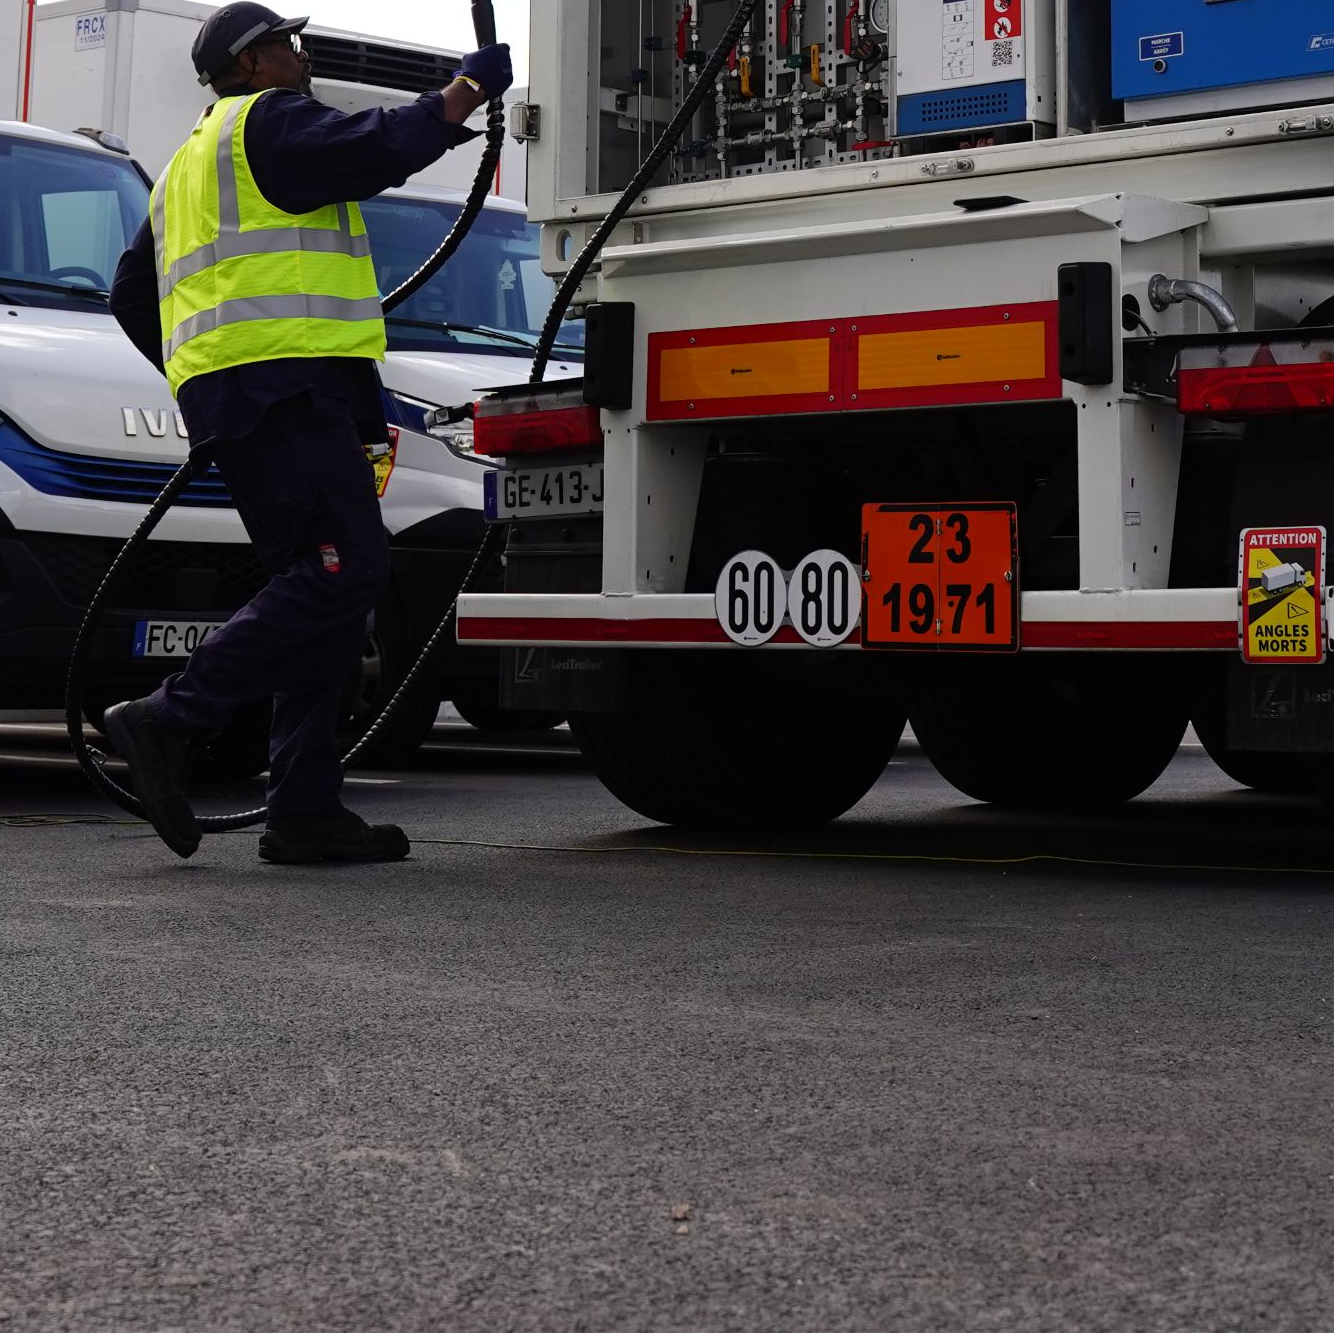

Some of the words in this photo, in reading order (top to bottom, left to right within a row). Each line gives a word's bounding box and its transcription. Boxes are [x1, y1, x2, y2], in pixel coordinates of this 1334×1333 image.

[77, 16, 105, 36] FRCX
[908, 513, 971, 564] 23
[1250, 532, 1317, 546] ATTENTION
[729, 561, 774, 634] 60
[801, 561, 849, 635] 80
[882, 583, 995, 634] 1971
[147, 624, 222, 654] FC-0
[1255, 624, 1309, 638] ANGLES
[1258, 640, 1307, 653] MORTS
